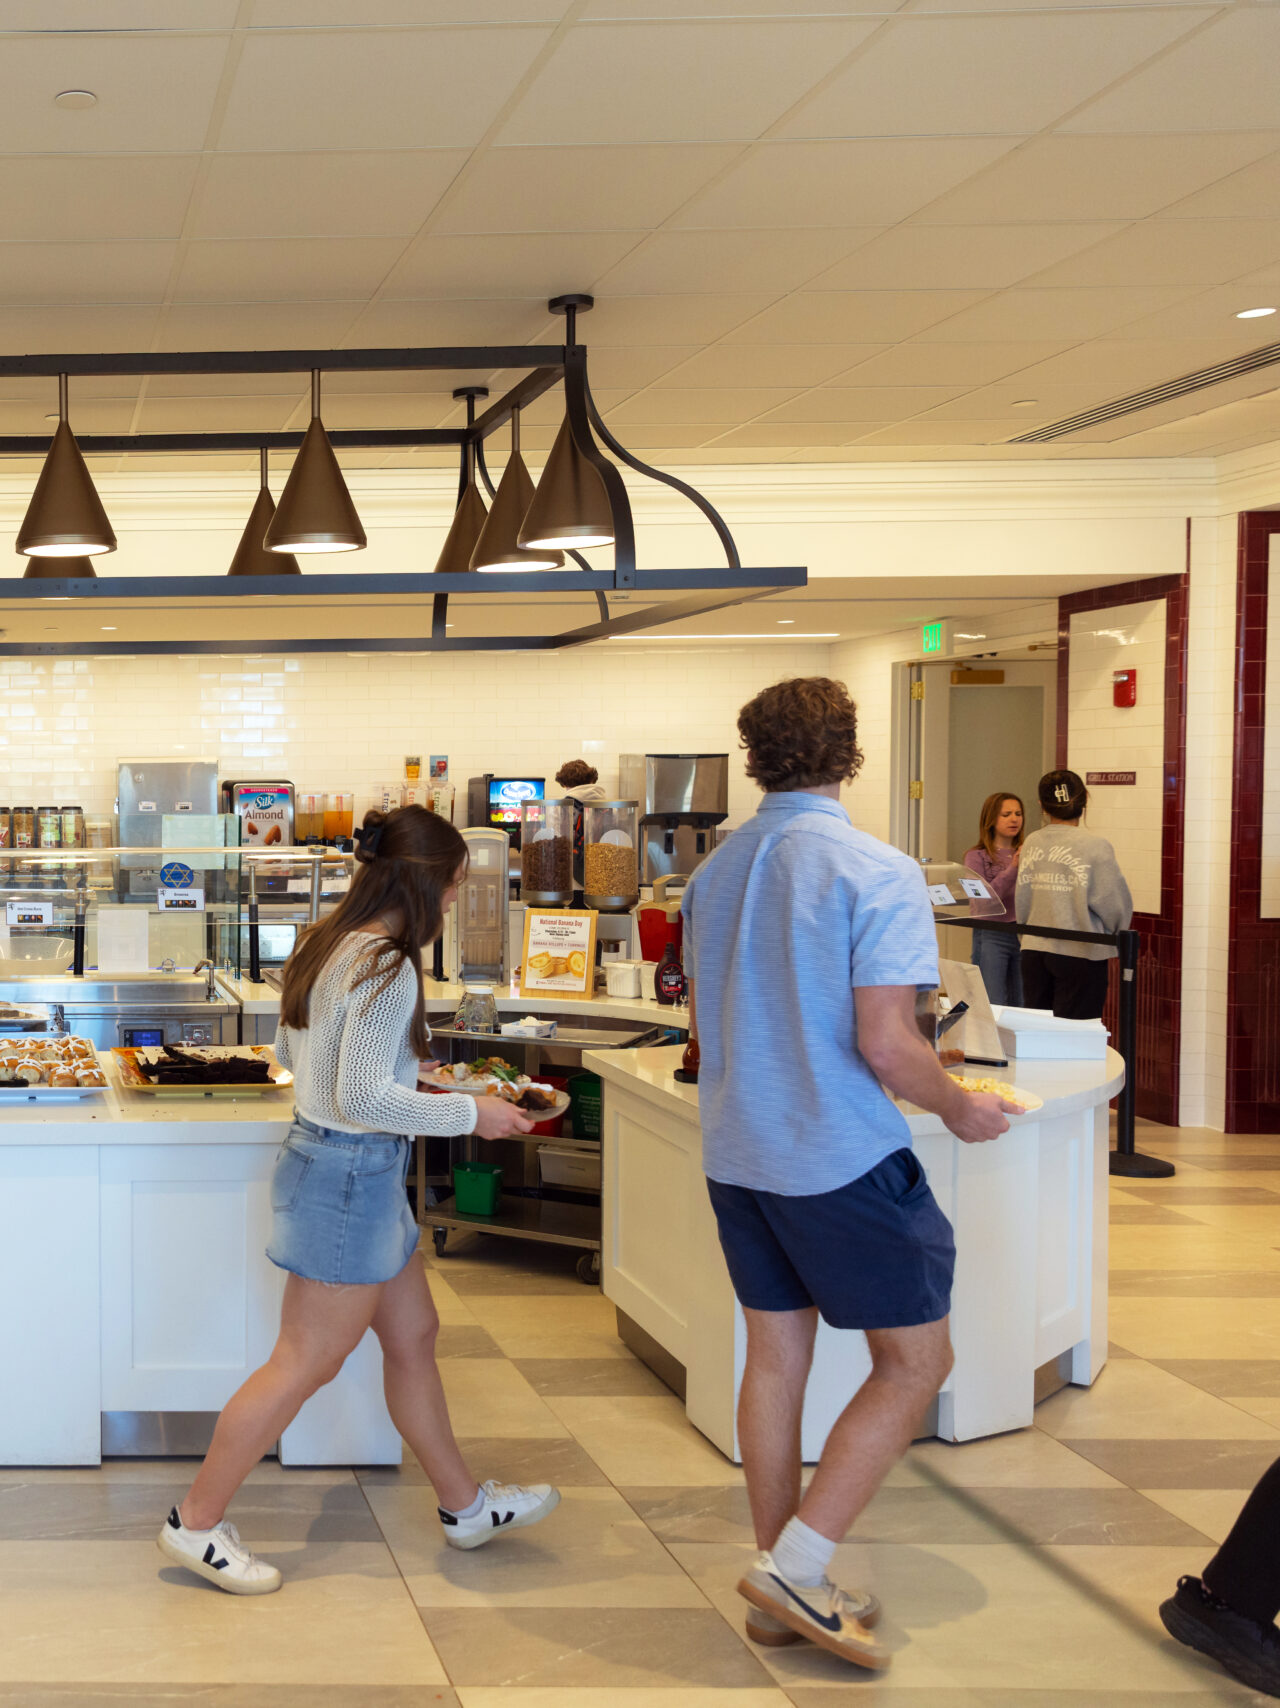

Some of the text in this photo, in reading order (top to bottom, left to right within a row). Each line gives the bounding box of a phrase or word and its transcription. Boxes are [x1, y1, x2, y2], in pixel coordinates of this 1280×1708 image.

[923, 624, 941, 652] EXIT
[1107, 773, 1134, 782] STATION
[254, 795, 273, 809] Silk
[245, 809, 284, 820] Almond
[540, 918, 558, 926] National
[574, 920, 584, 928] Day
